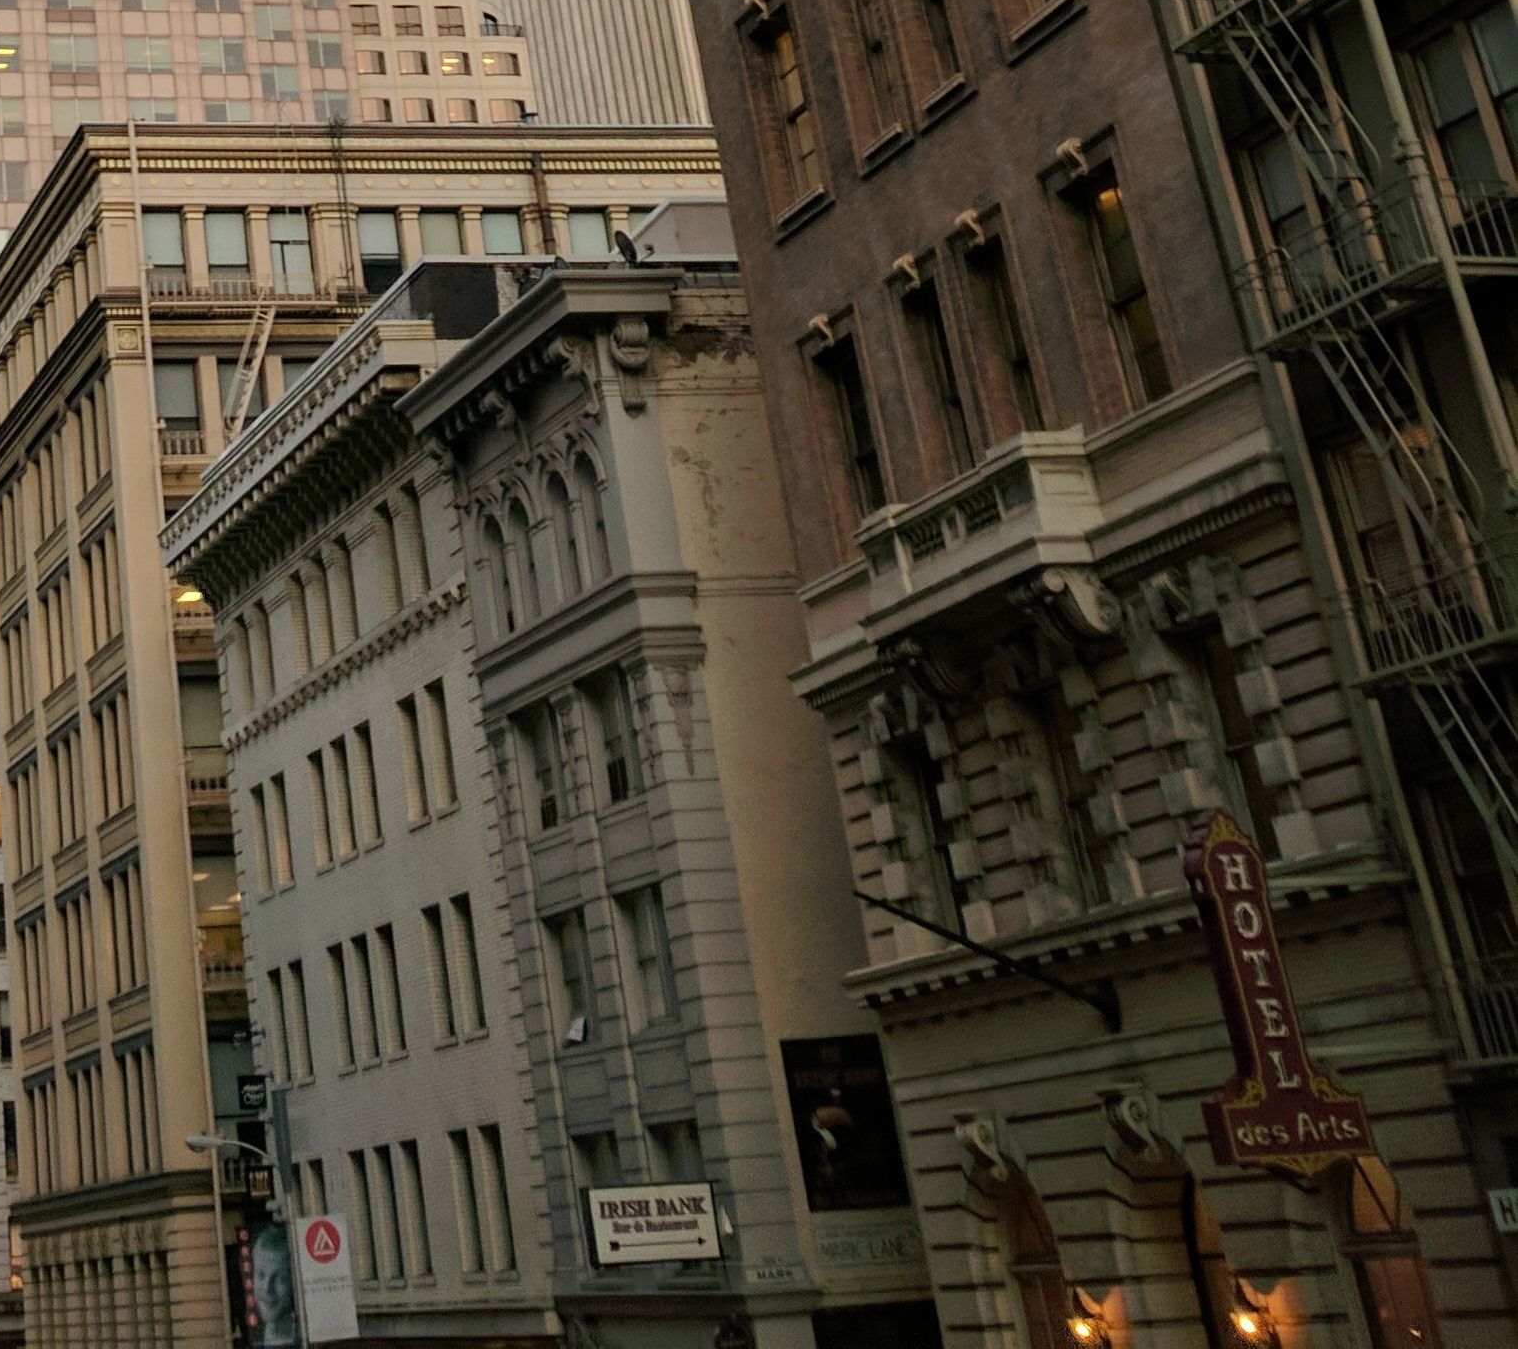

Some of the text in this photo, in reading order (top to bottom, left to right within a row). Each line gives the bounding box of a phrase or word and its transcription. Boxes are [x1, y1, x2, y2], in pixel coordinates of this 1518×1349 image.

[1215, 852, 1302, 1090] HOTEL
[1236, 1113, 1362, 1148] des Arts
[598, 1196, 707, 1220] IRISH BANK
